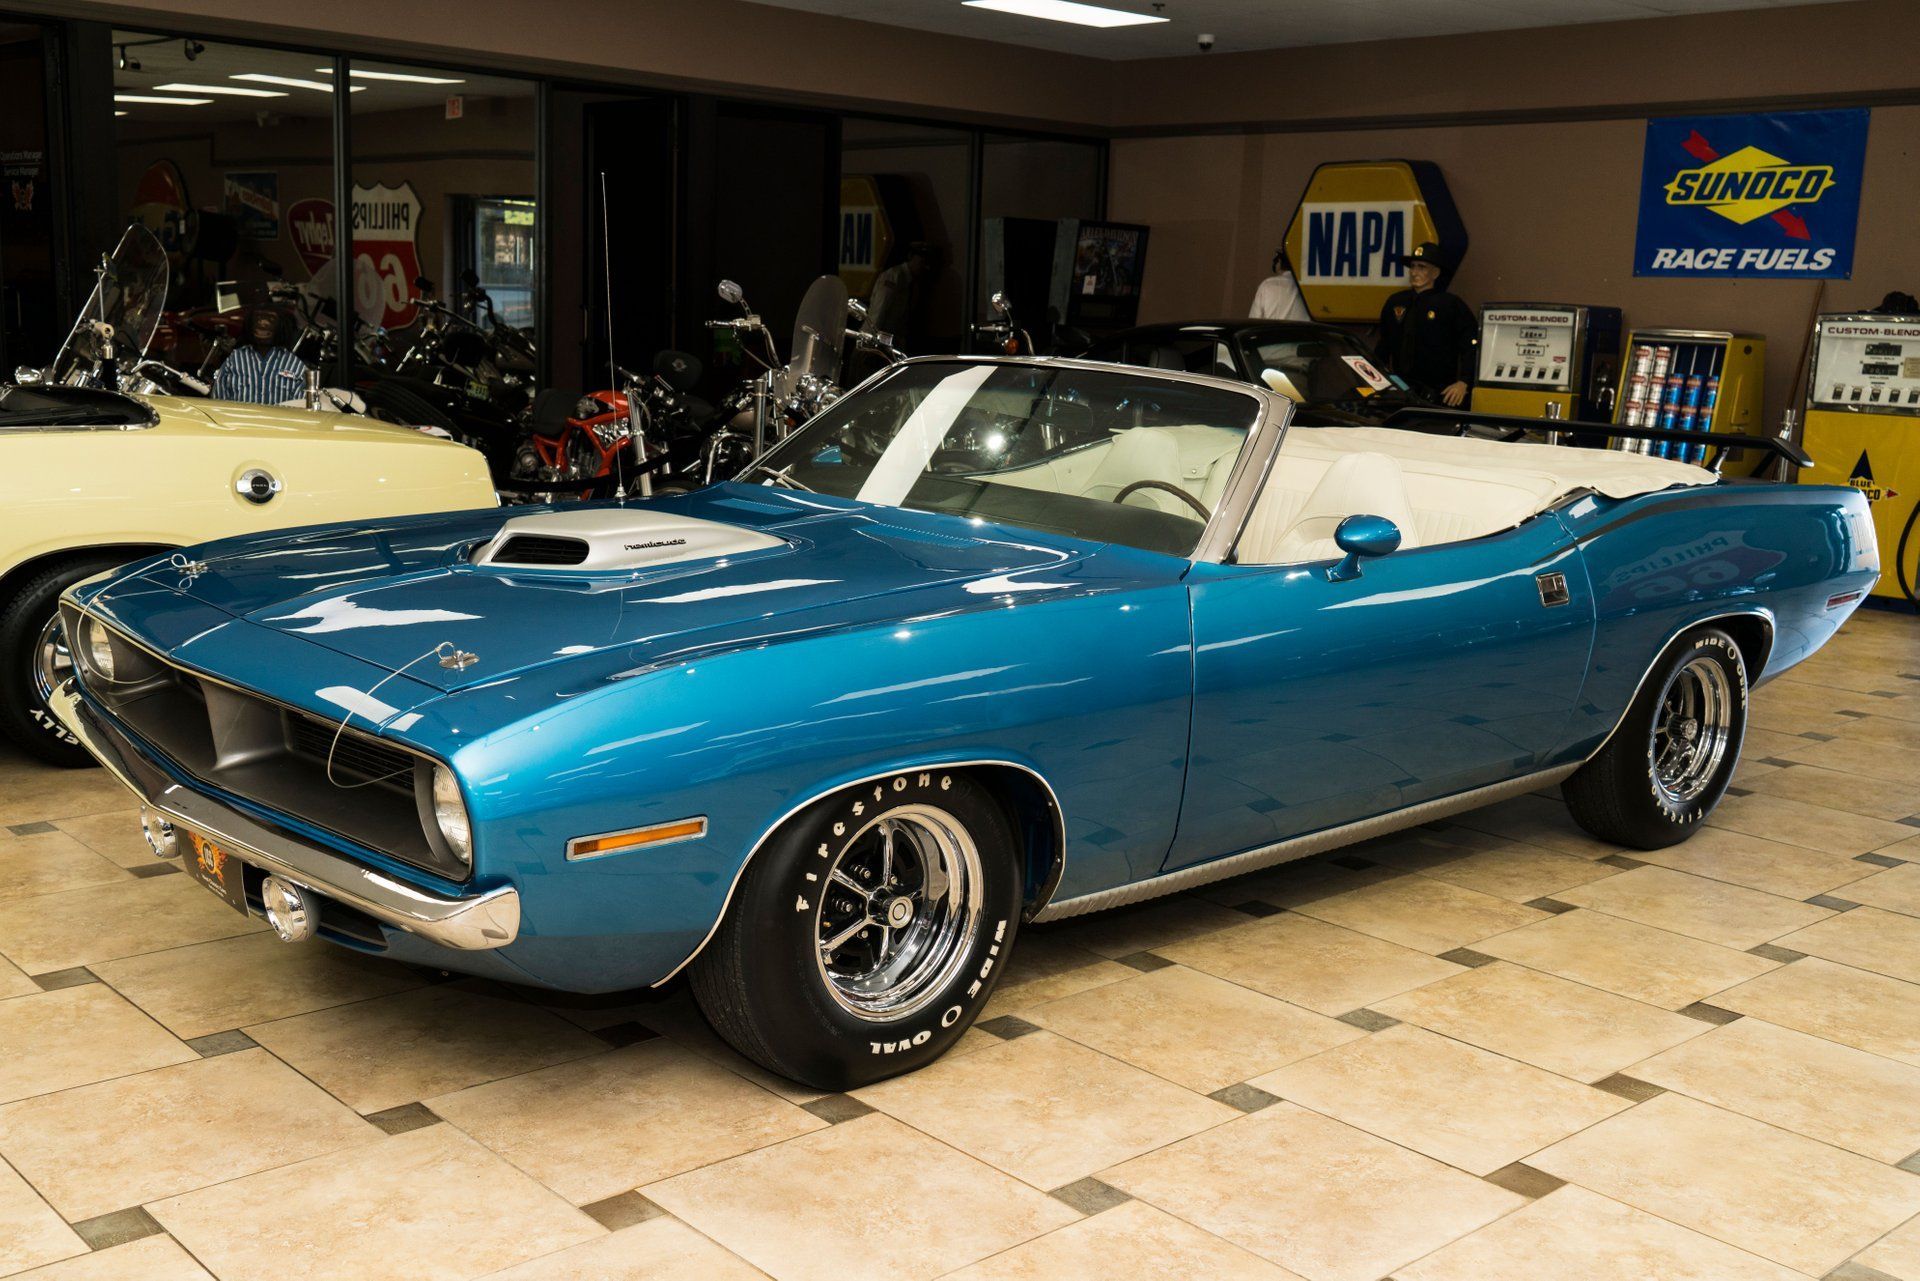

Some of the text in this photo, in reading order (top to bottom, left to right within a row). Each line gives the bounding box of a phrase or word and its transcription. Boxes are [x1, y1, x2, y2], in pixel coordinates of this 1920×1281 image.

[1671, 169, 1828, 200] SUNOCO
[1308, 211, 1404, 277] NAPA
[1651, 248, 1836, 271] RACE FUELS
[1850, 479, 1872, 487] BLUE
[1695, 638, 1726, 650] WIDE
[29, 709, 80, 745] ELLY
[967, 919, 1007, 999] WIDE
[869, 1030, 932, 1055] OVAL
